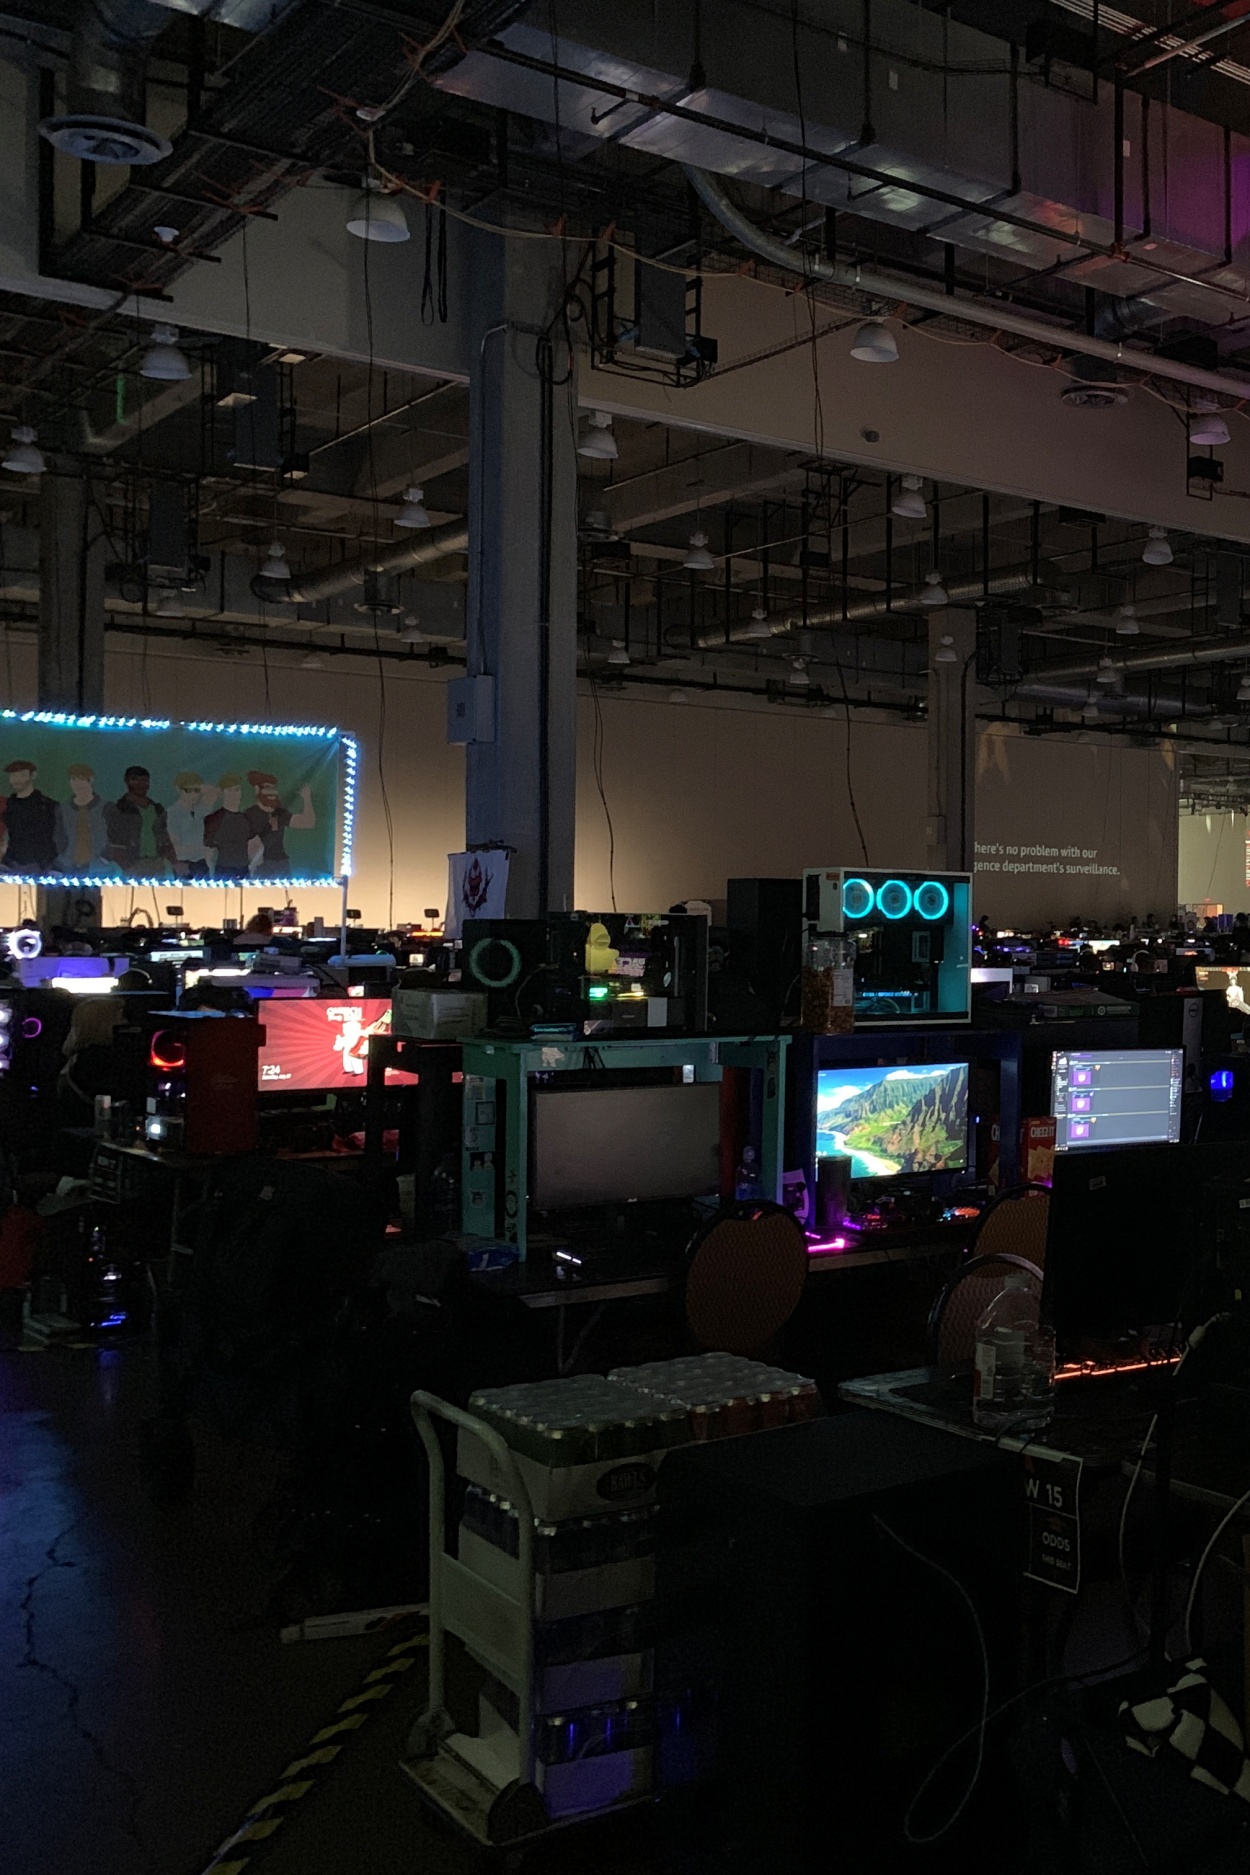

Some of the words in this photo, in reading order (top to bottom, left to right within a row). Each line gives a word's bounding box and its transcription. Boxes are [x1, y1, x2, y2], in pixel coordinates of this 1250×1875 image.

[974, 842, 1003, 854] here's
[1006, 845, 1018, 855] no
[1020, 845, 1059, 858] problem
[1060, 846, 1081, 858] with
[1082, 849, 1098, 859] our
[1002, 860, 1065, 875] department's
[1066, 863, 1120, 876] surveillance.
[1026, 1478, 1040, 1499] W
[1045, 1483, 1063, 1509] 15
[1041, 1531, 1071, 1553] ODDS
